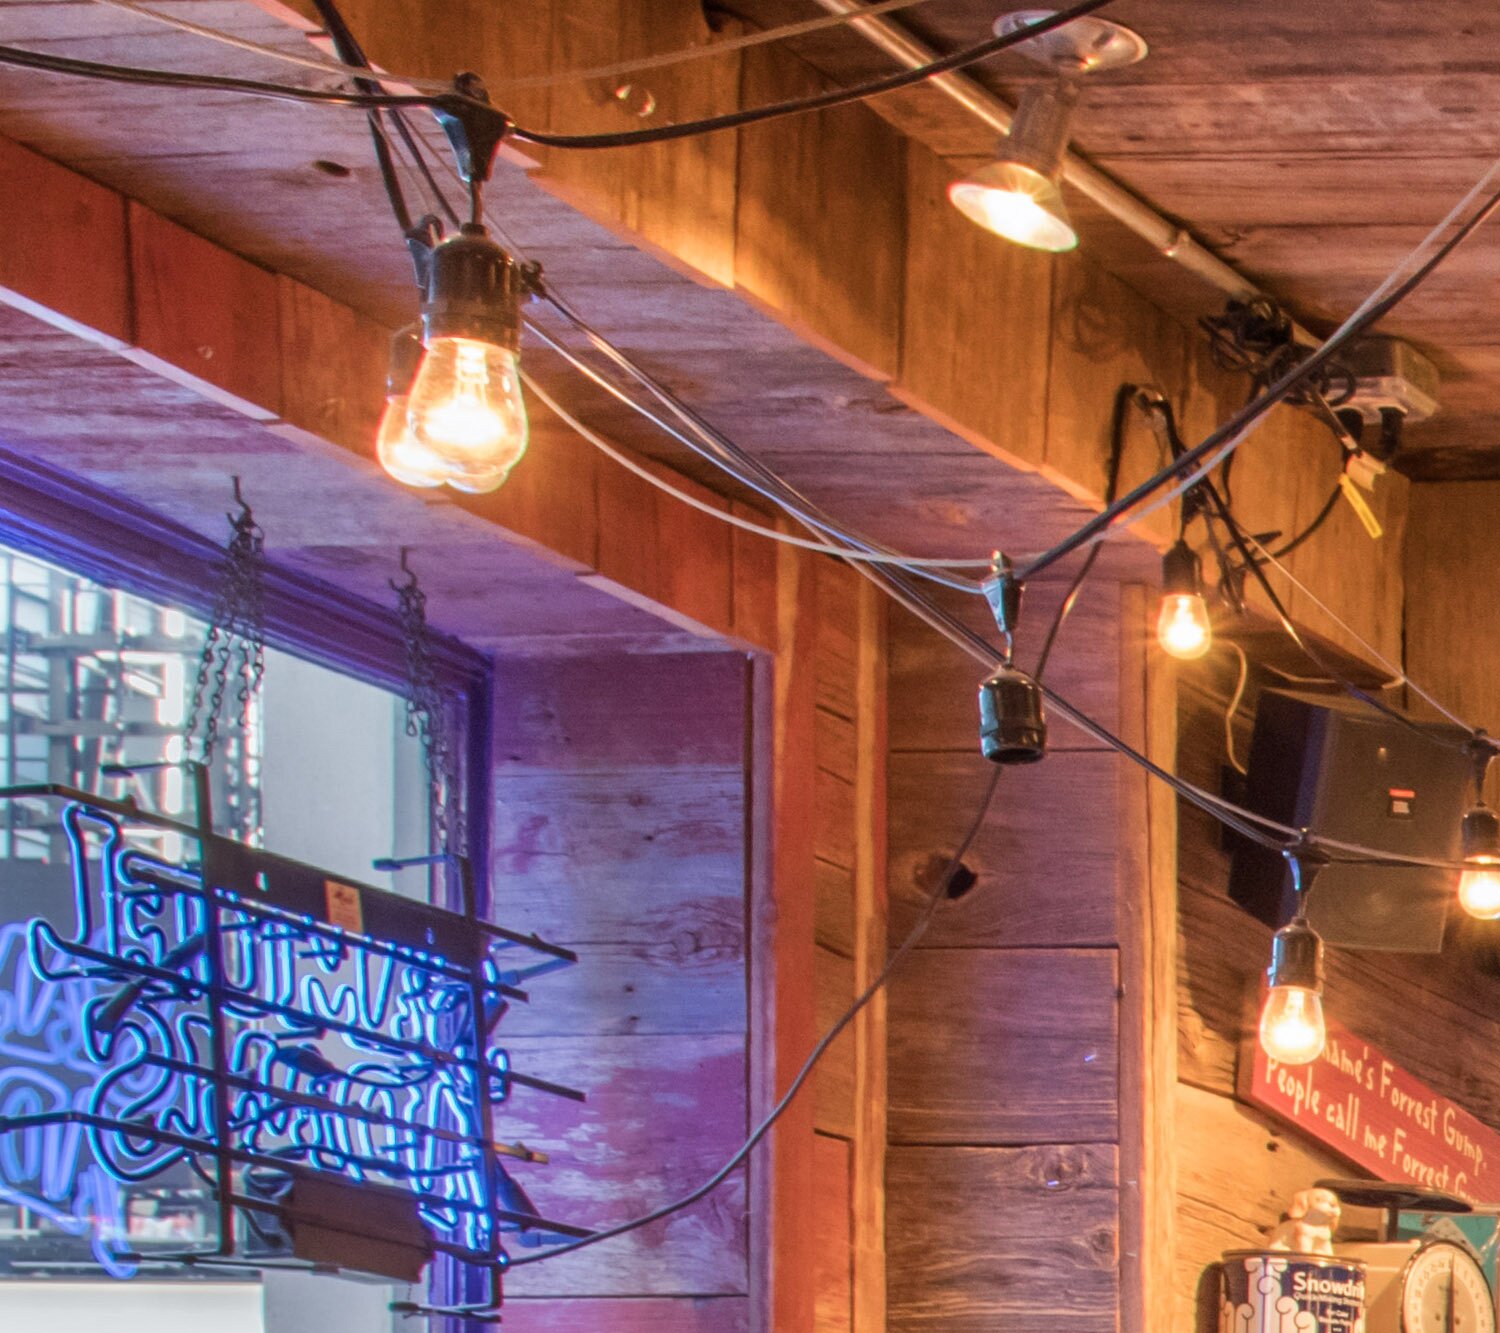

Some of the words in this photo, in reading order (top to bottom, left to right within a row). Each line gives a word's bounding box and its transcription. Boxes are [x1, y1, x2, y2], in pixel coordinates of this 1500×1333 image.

[1266, 1056, 1320, 1115] People
[1326, 1093, 1360, 1140] call
[1365, 1125, 1387, 1158] me
[1392, 1128, 1449, 1189] Forrest
[1380, 1061, 1437, 1134] Forrest
[1444, 1107, 1488, 1175] Gump.
